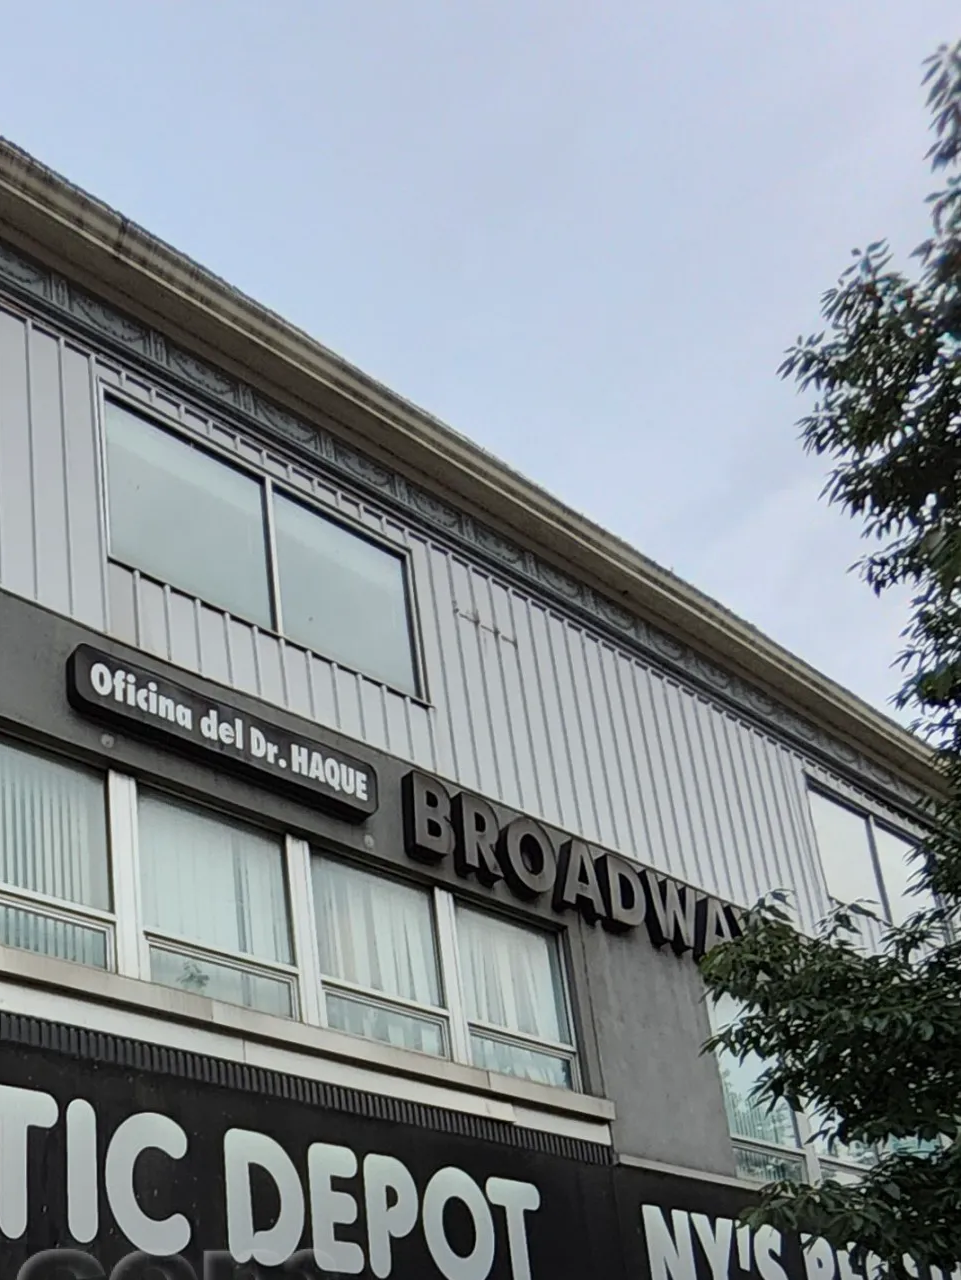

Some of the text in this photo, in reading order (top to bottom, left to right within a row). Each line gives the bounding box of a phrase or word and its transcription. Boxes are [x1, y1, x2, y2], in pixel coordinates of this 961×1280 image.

[90, 662, 369, 801] Oficina del Dr. HAQUE
[402, 770, 748, 958] BROADWA
